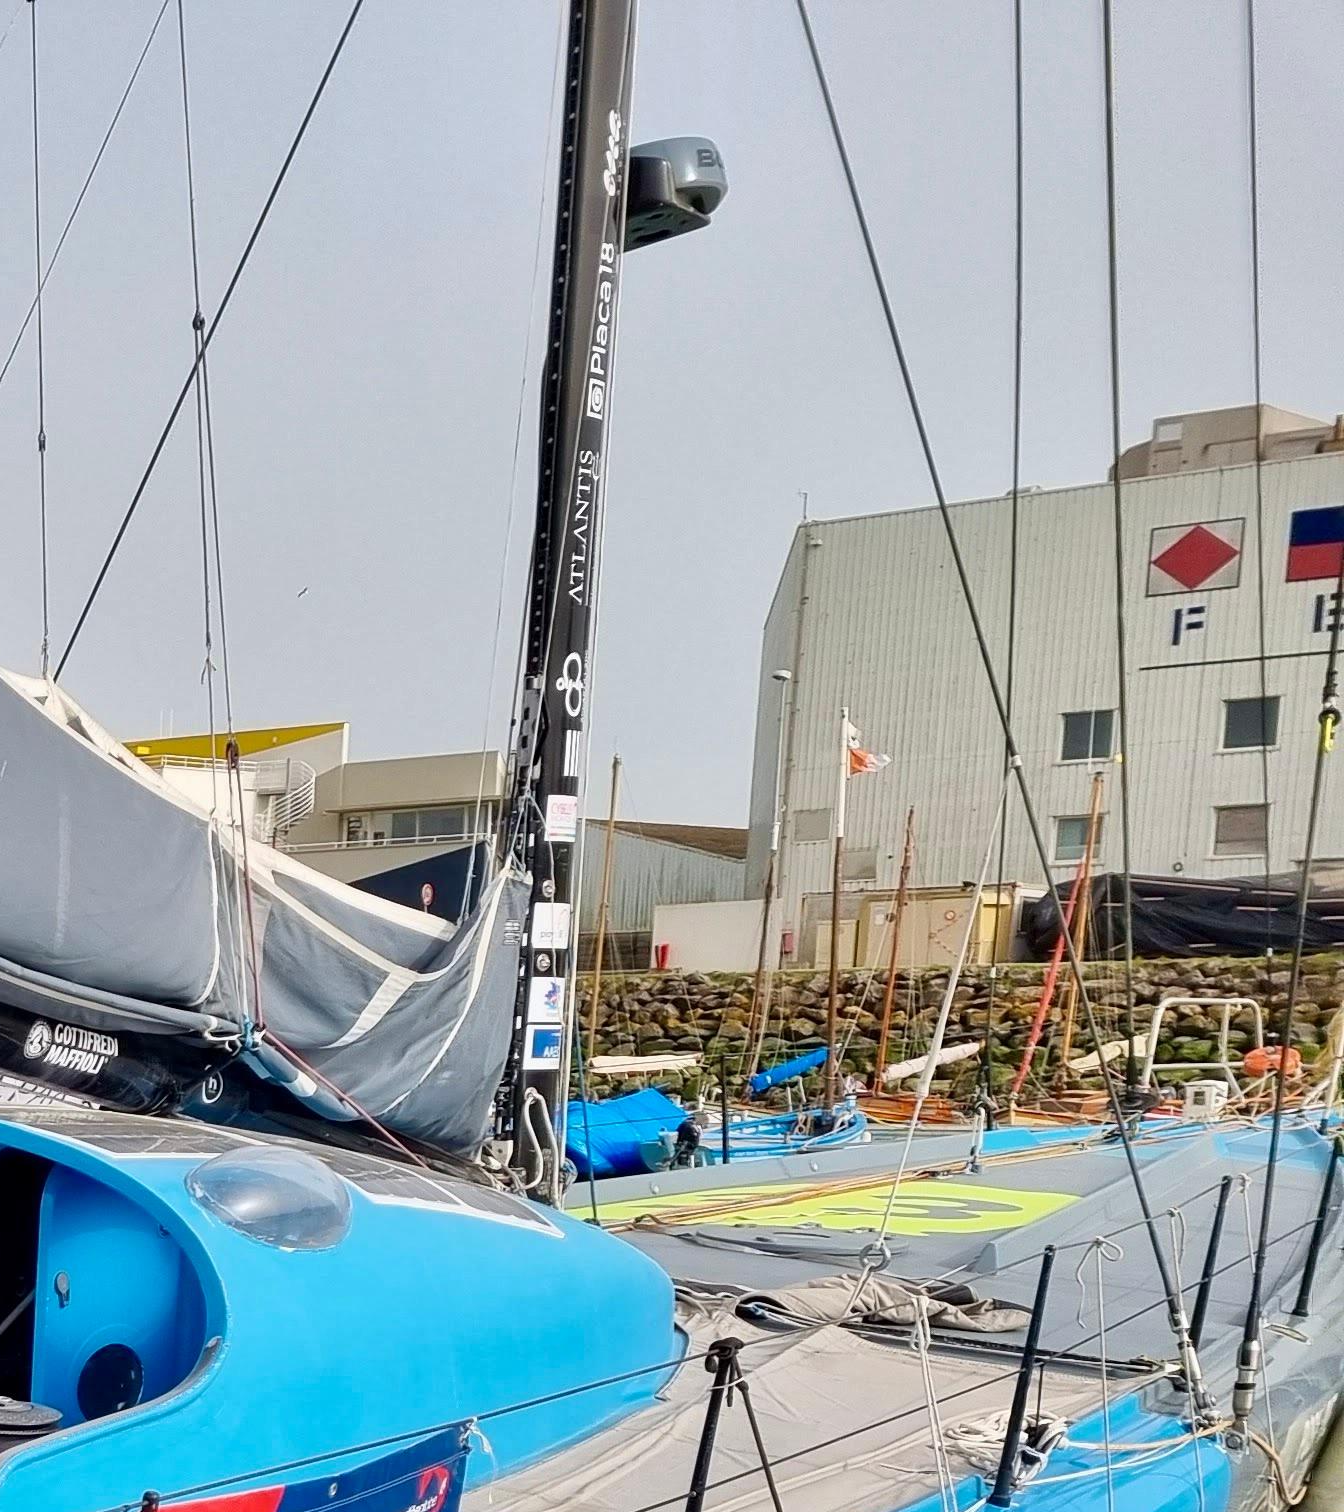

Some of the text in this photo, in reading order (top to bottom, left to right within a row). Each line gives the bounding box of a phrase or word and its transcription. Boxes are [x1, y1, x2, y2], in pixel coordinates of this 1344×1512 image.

[568, 450, 594, 606] ATLANTIS
[1171, 605, 1205, 646] F
[54, 1023, 119, 1057] GOTTIFREDI
[43, 1044, 106, 1075] MAFFIOLI
